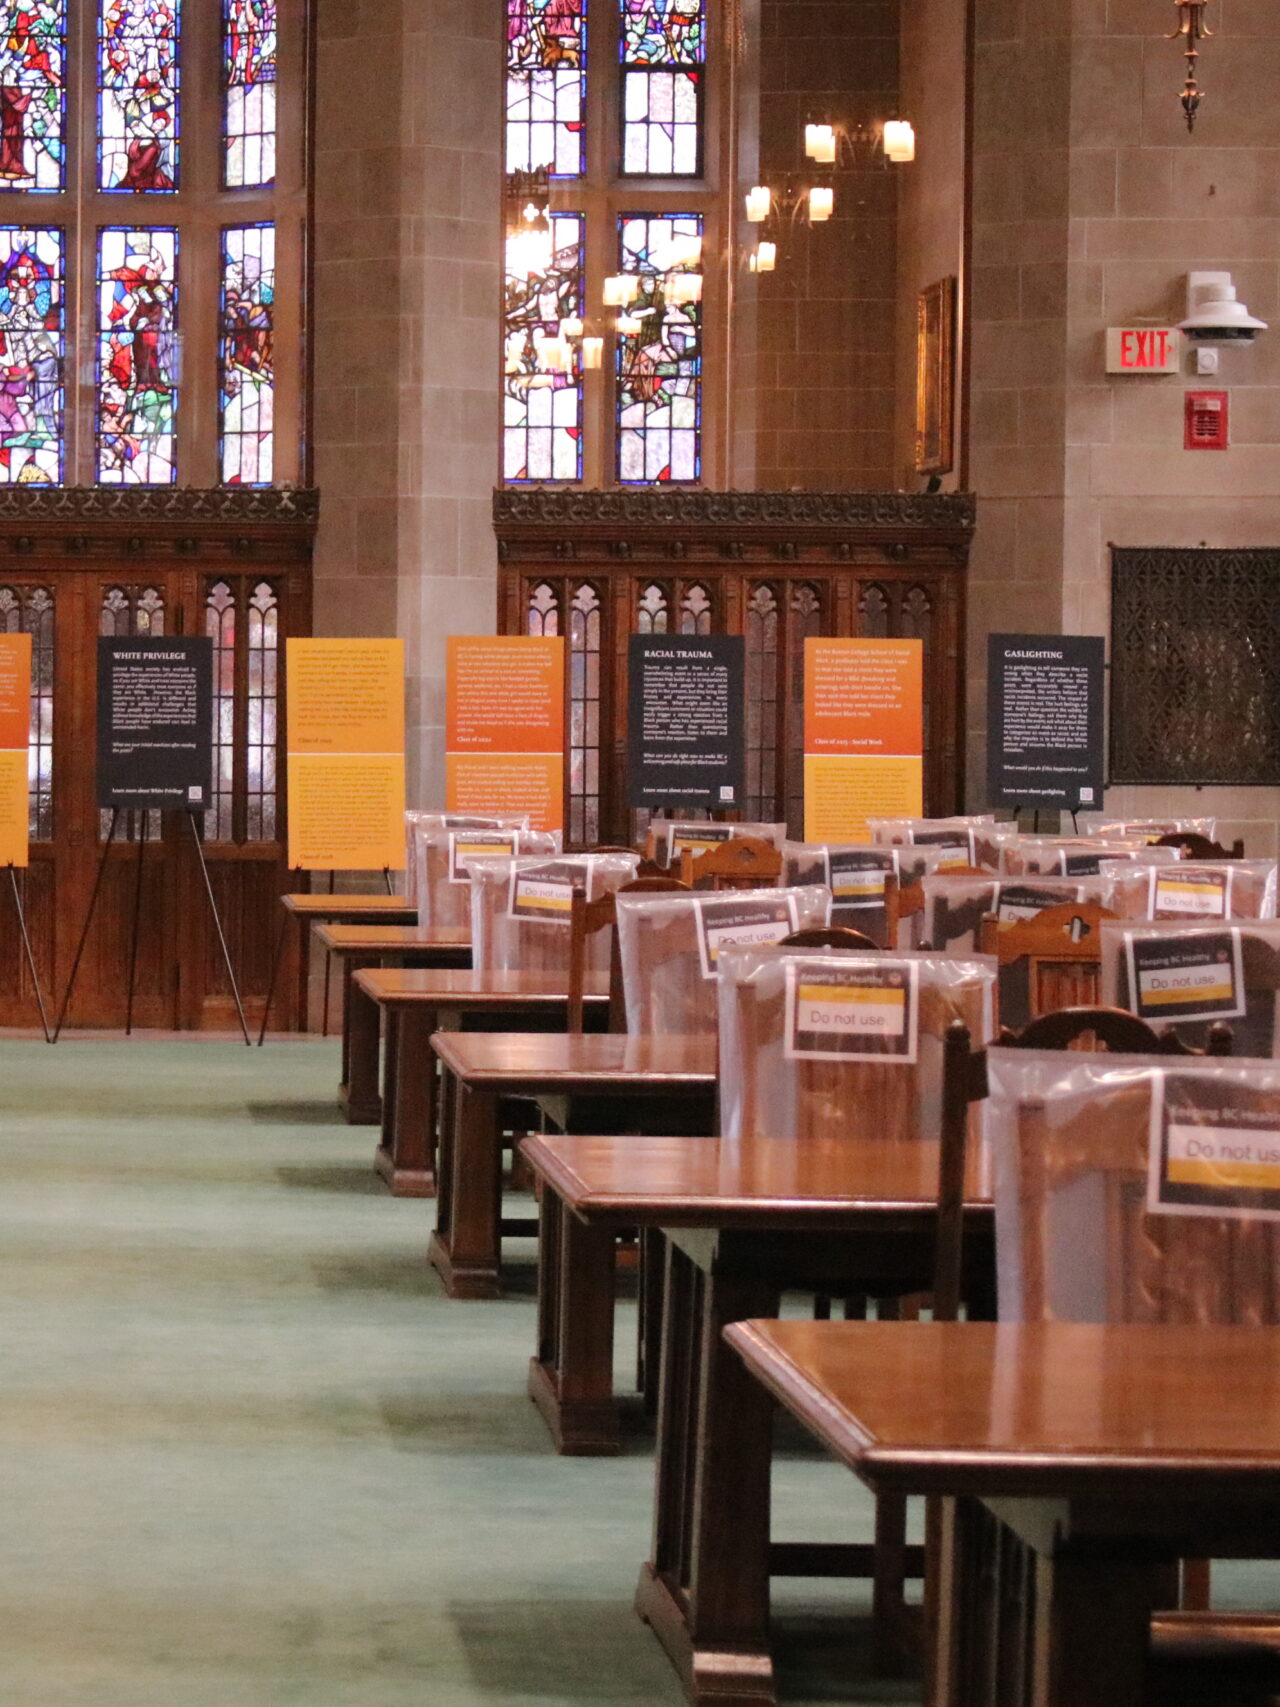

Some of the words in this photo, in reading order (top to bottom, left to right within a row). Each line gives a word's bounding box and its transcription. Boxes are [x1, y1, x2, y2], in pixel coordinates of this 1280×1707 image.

[1121, 331, 1169, 368] EXIT
[113, 651, 141, 660] WHITE
[143, 651, 187, 660] PRIVILEGE
[644, 649, 675, 658] RACIAL
[676, 650, 714, 659] TRAUMA
[1004, 649, 1064, 659] GASLIGHTING
[1140, 957, 1169, 967] Keeping
[1171, 954, 1181, 964] BC
[1182, 953, 1211, 963] Healthy
[801, 973, 835, 985] Keeping
[836, 973, 848, 984] BC
[850, 974, 883, 986] Healthy
[1151, 978, 1169, 990] Do
[1171, 976, 1191, 988] not
[1194, 975, 1216, 987] use
[810, 1010, 830, 1024] Do
[834, 1013, 856, 1025] not
[1221, 1107, 1239, 1120] BC
[1186, 1139, 1215, 1159] Do
[1220, 1144, 1251, 1161] not
[1257, 1148, 1280, 1162] us
